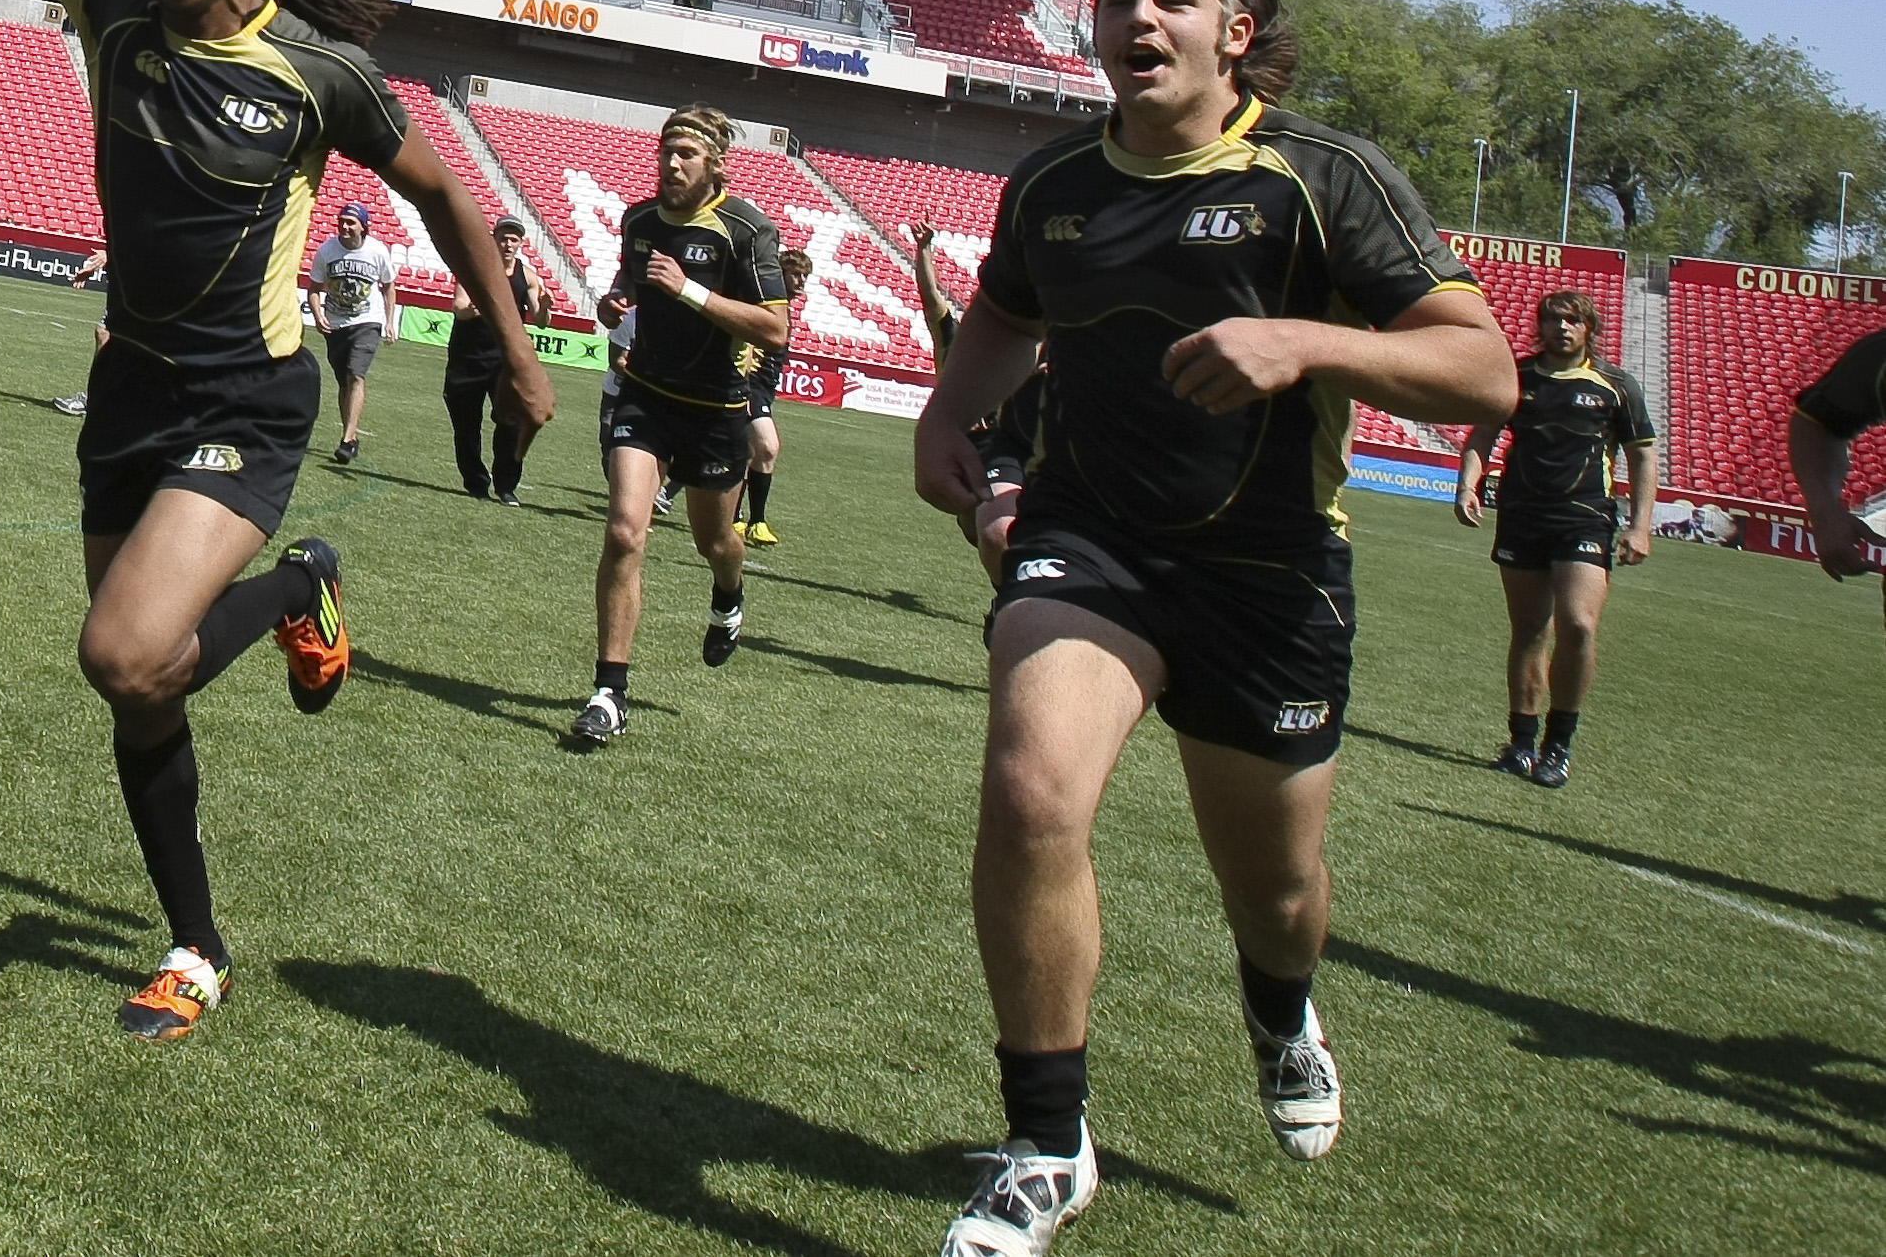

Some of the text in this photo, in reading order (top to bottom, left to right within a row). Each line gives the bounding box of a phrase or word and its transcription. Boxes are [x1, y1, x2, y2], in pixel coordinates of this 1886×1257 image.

[797, 40, 870, 77] bank
[11, 248, 77, 280] Rugby
[1449, 234, 1563, 269] CORNER
